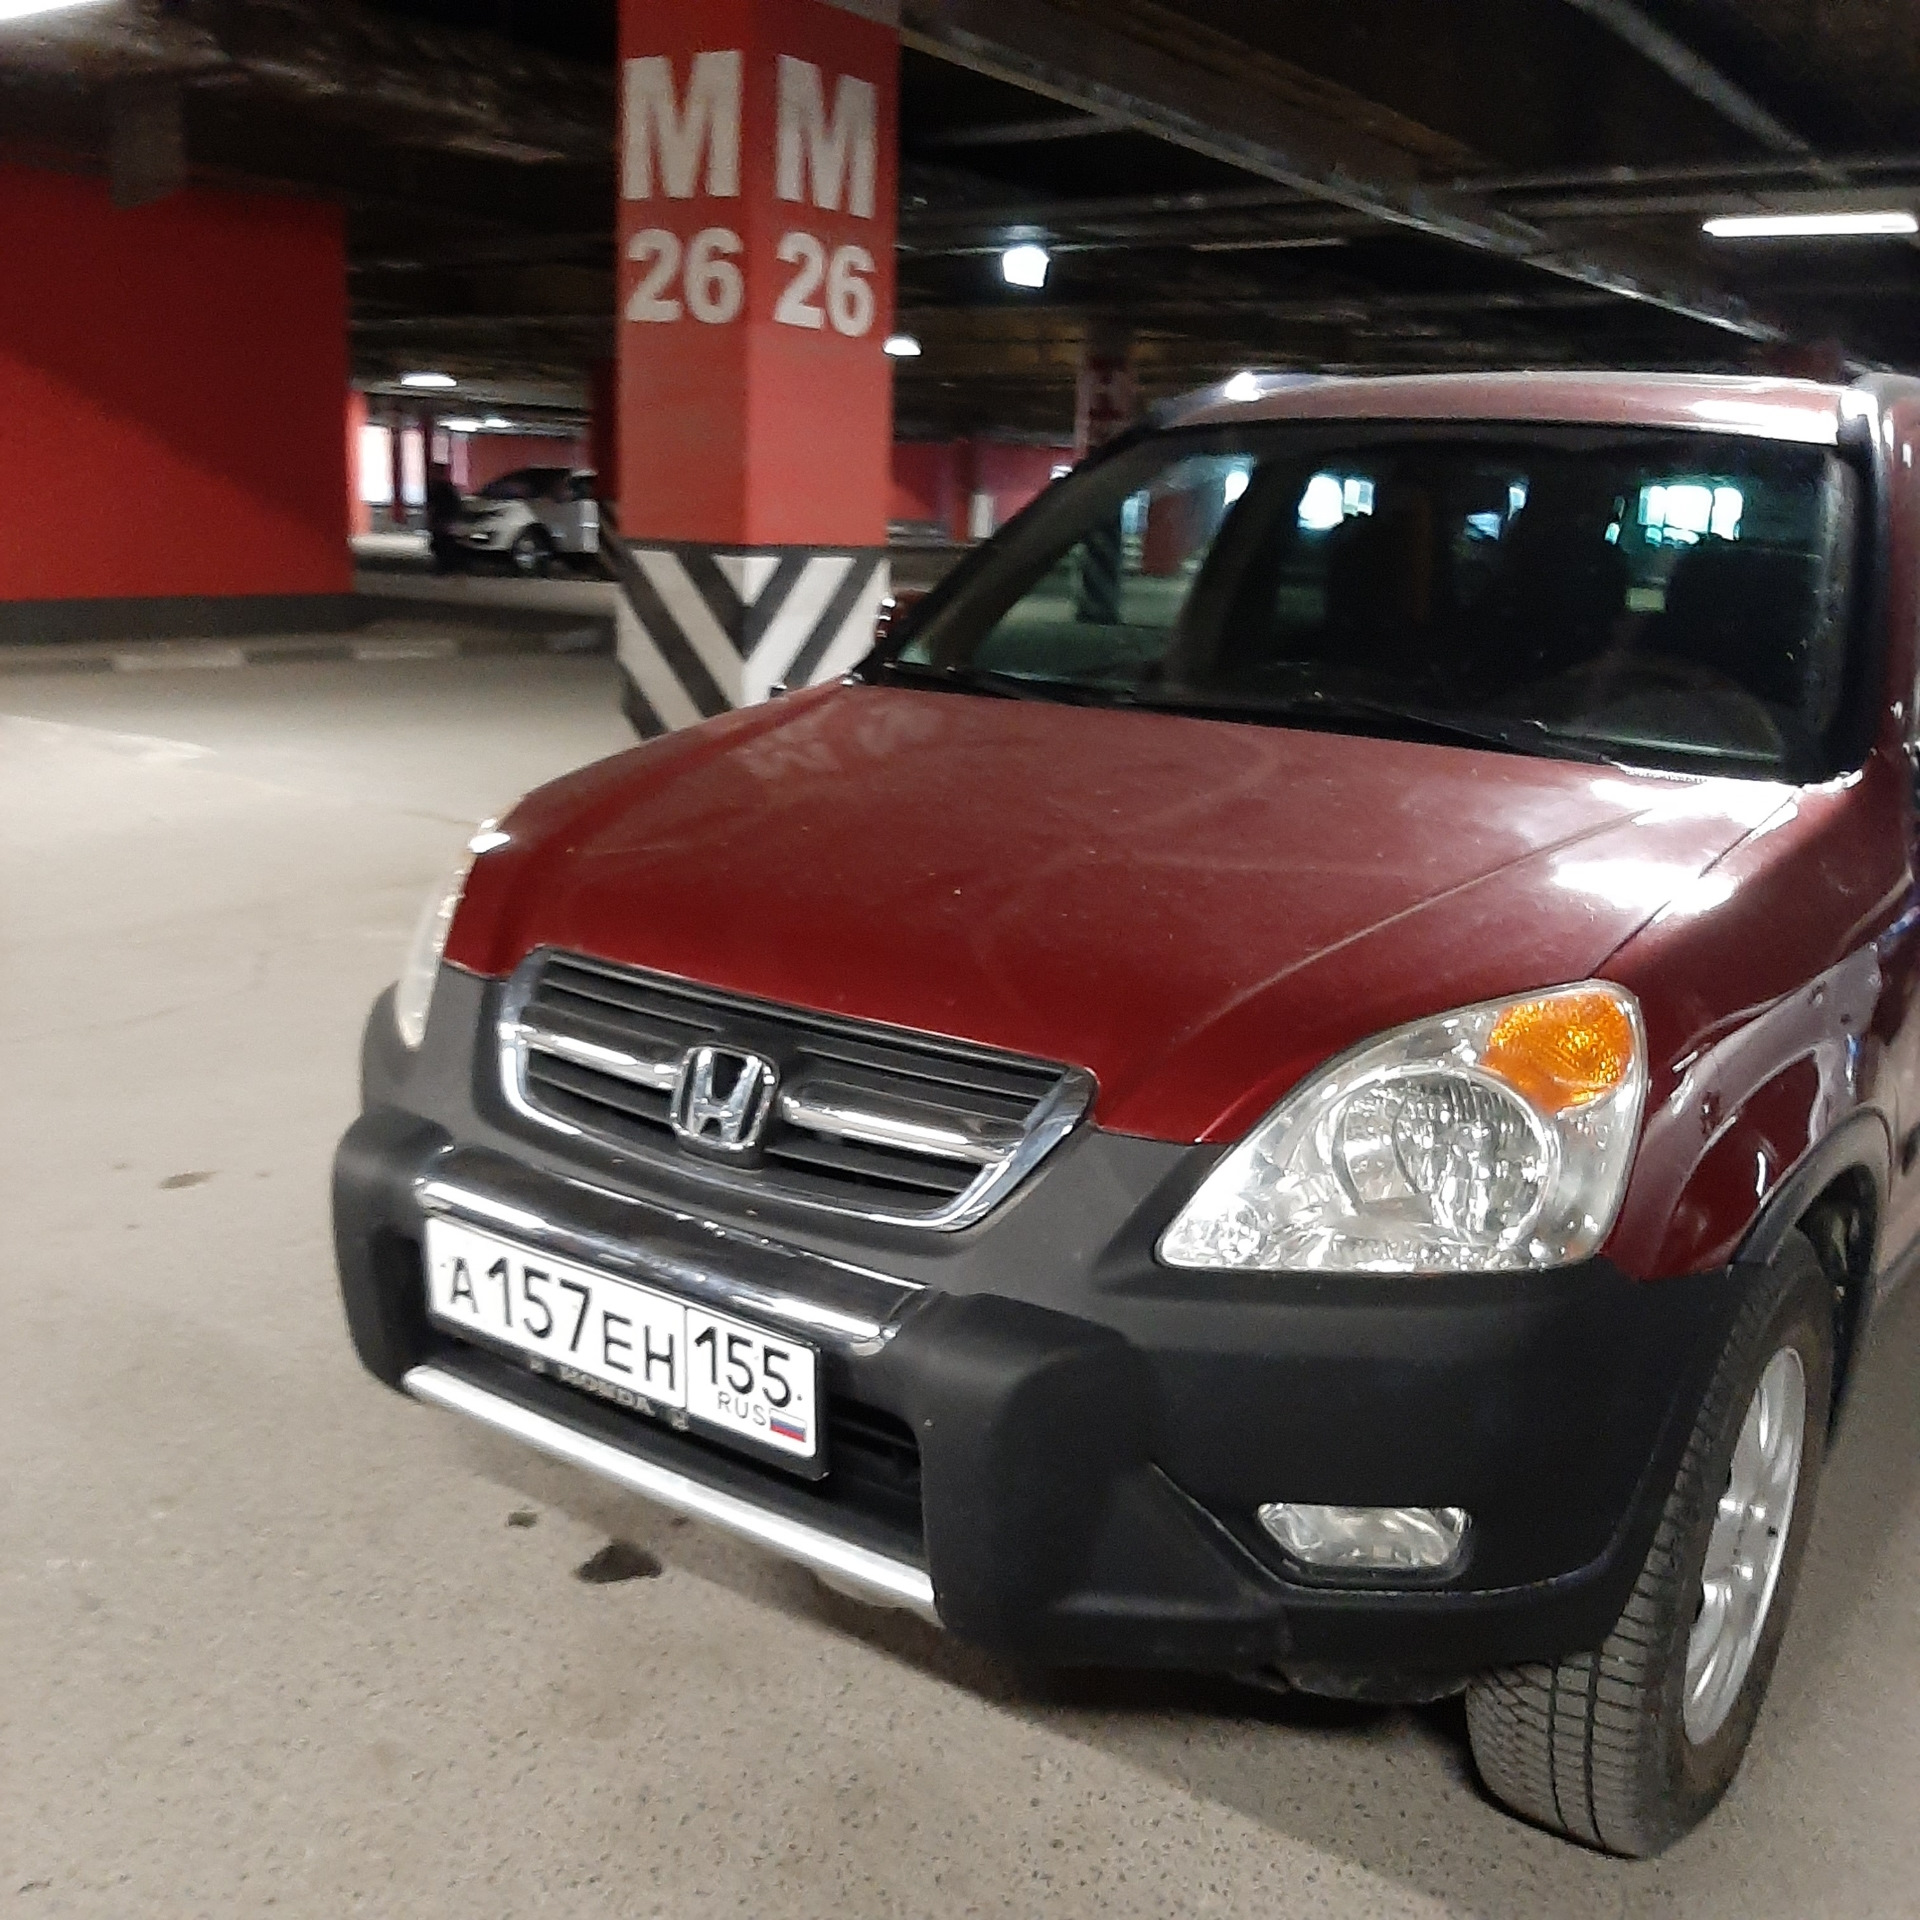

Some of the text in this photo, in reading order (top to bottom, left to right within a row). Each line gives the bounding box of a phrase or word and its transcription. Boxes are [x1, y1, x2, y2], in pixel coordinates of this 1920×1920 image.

[622, 50, 743, 201] M
[775, 53, 877, 219] M
[624, 227, 744, 324] 26
[775, 231, 876, 337] 26
[695, 1325, 792, 1408] 155
[717, 1390, 767, 1427] RUS
